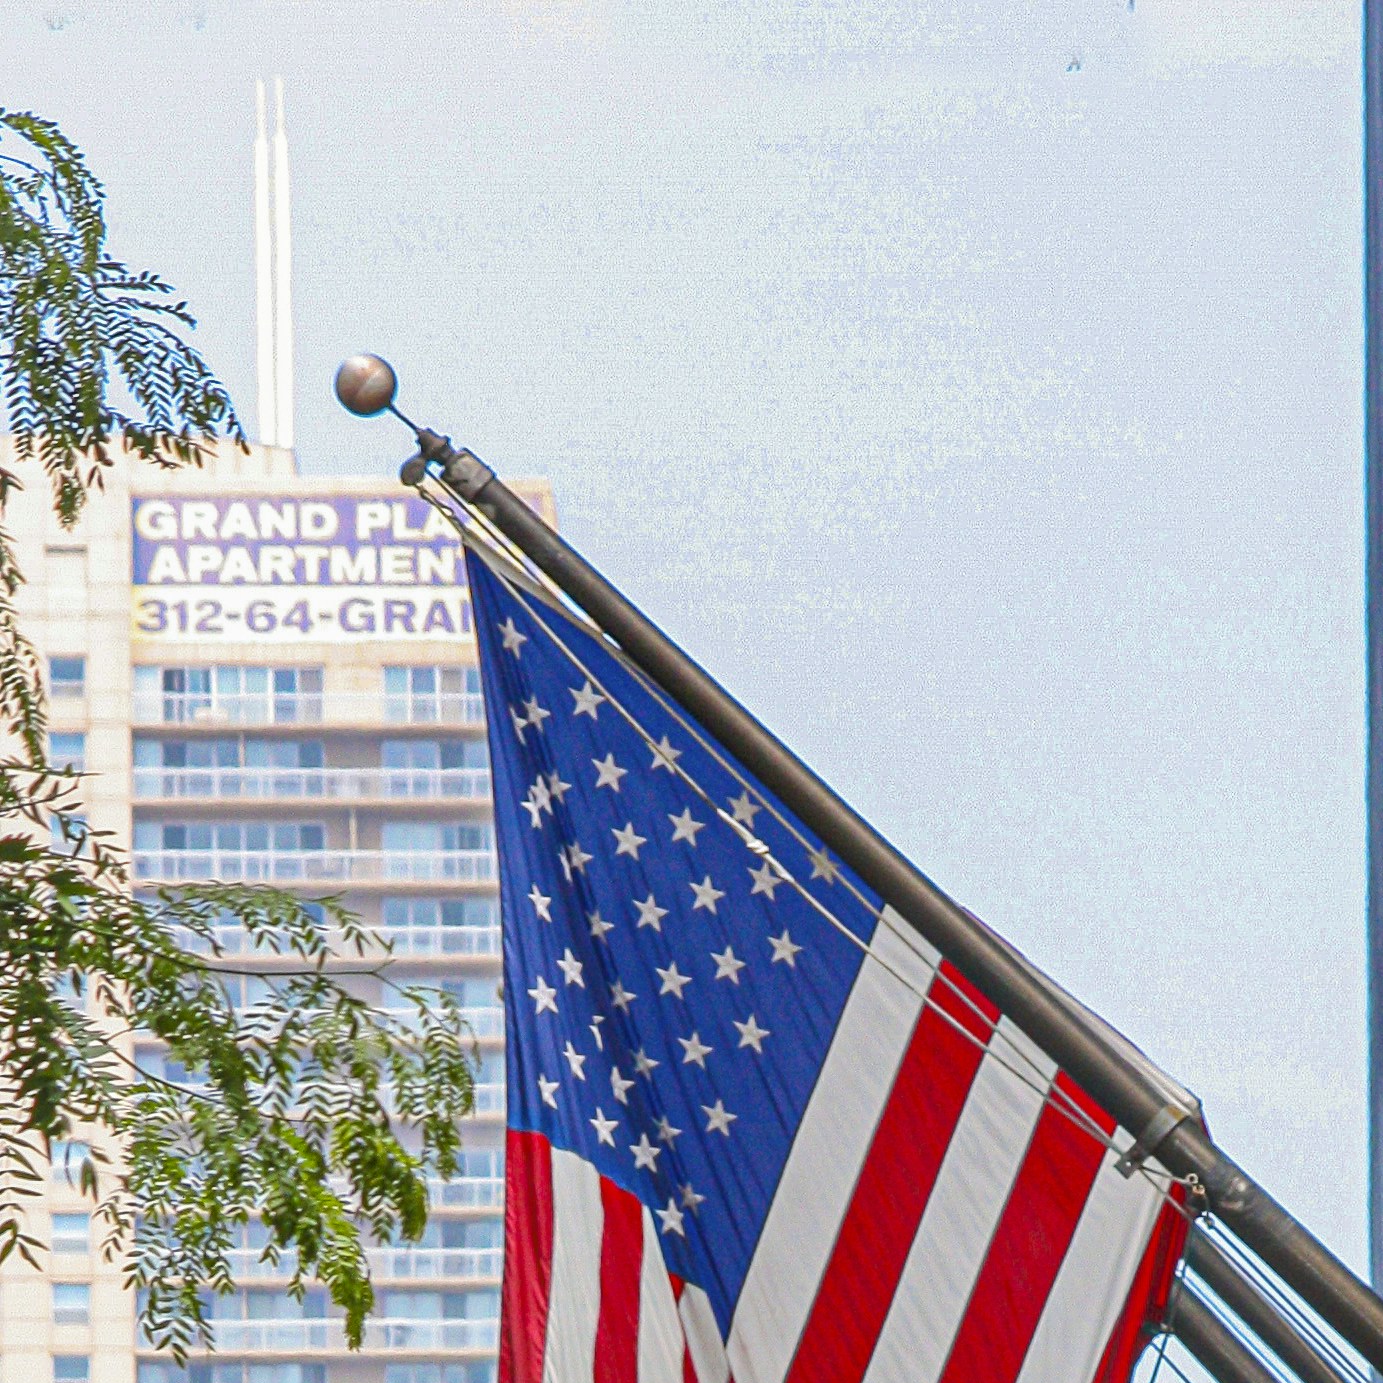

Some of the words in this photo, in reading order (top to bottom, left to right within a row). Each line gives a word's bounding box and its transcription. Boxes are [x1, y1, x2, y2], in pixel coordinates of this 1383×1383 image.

[135, 499, 339, 541] GRAND
[355, 500, 462, 541] PLA
[147, 543, 464, 584] APARTMEN
